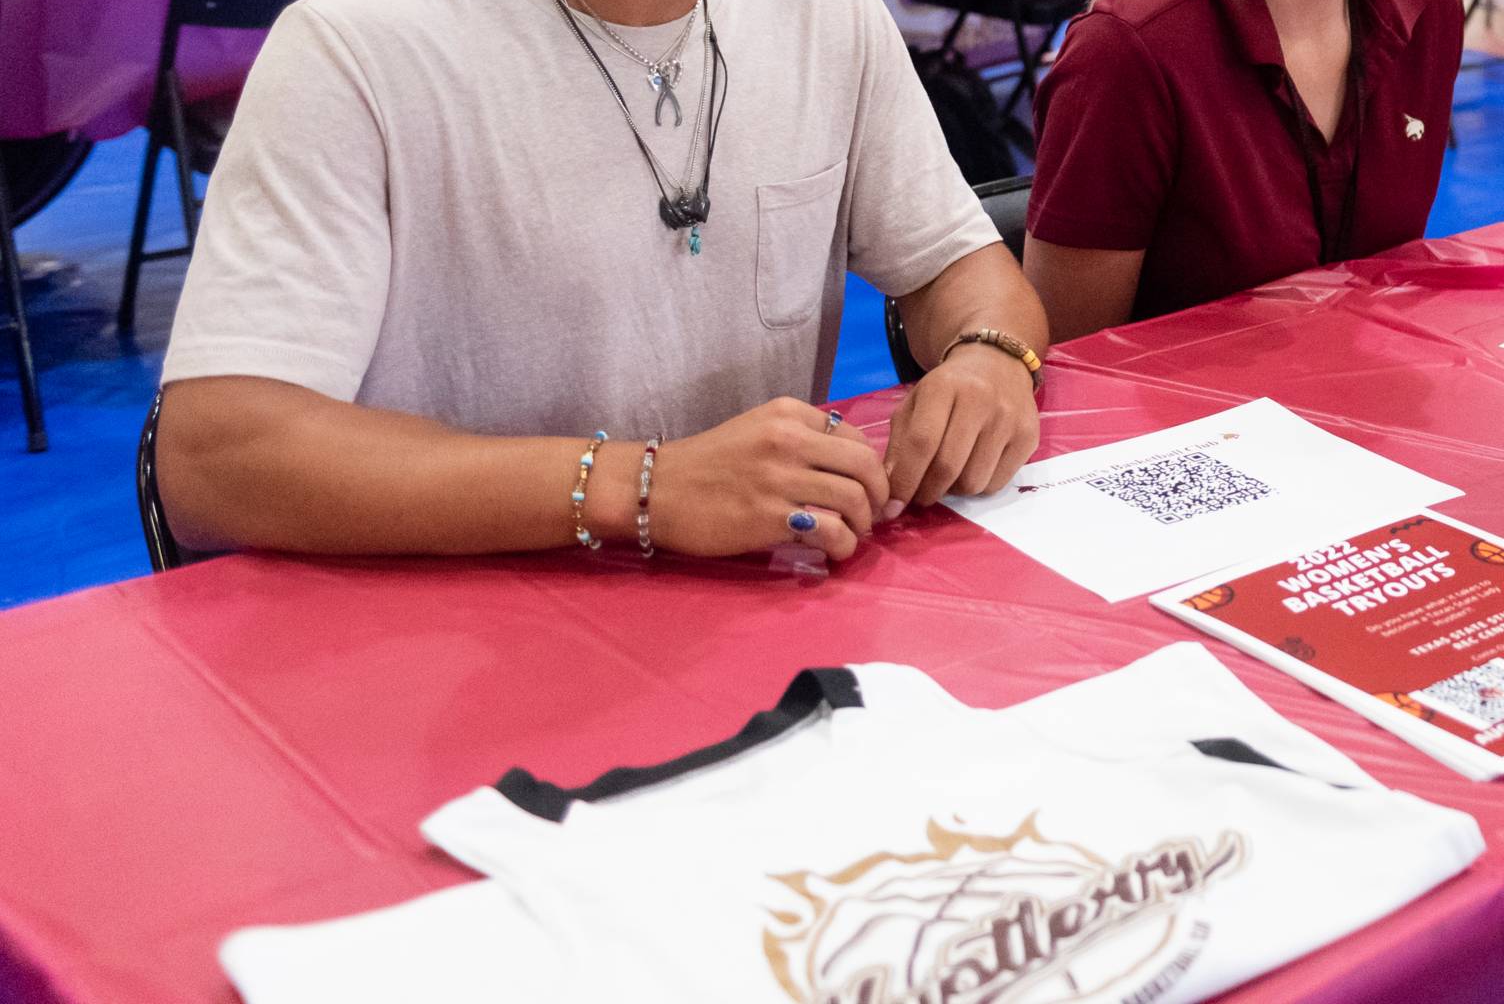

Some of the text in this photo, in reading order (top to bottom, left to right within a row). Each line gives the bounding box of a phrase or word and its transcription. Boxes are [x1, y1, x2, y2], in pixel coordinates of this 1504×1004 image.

[1184, 440, 1219, 454] Club
[1277, 539, 1411, 593] WOMEN'S
[1288, 541, 1359, 571] 2022
[1282, 546, 1450, 613] BASKETBALL
[1331, 562, 1456, 616] TRYOUTS
[1410, 637, 1450, 655] TEXAS
[1450, 621, 1488, 639] STATE
